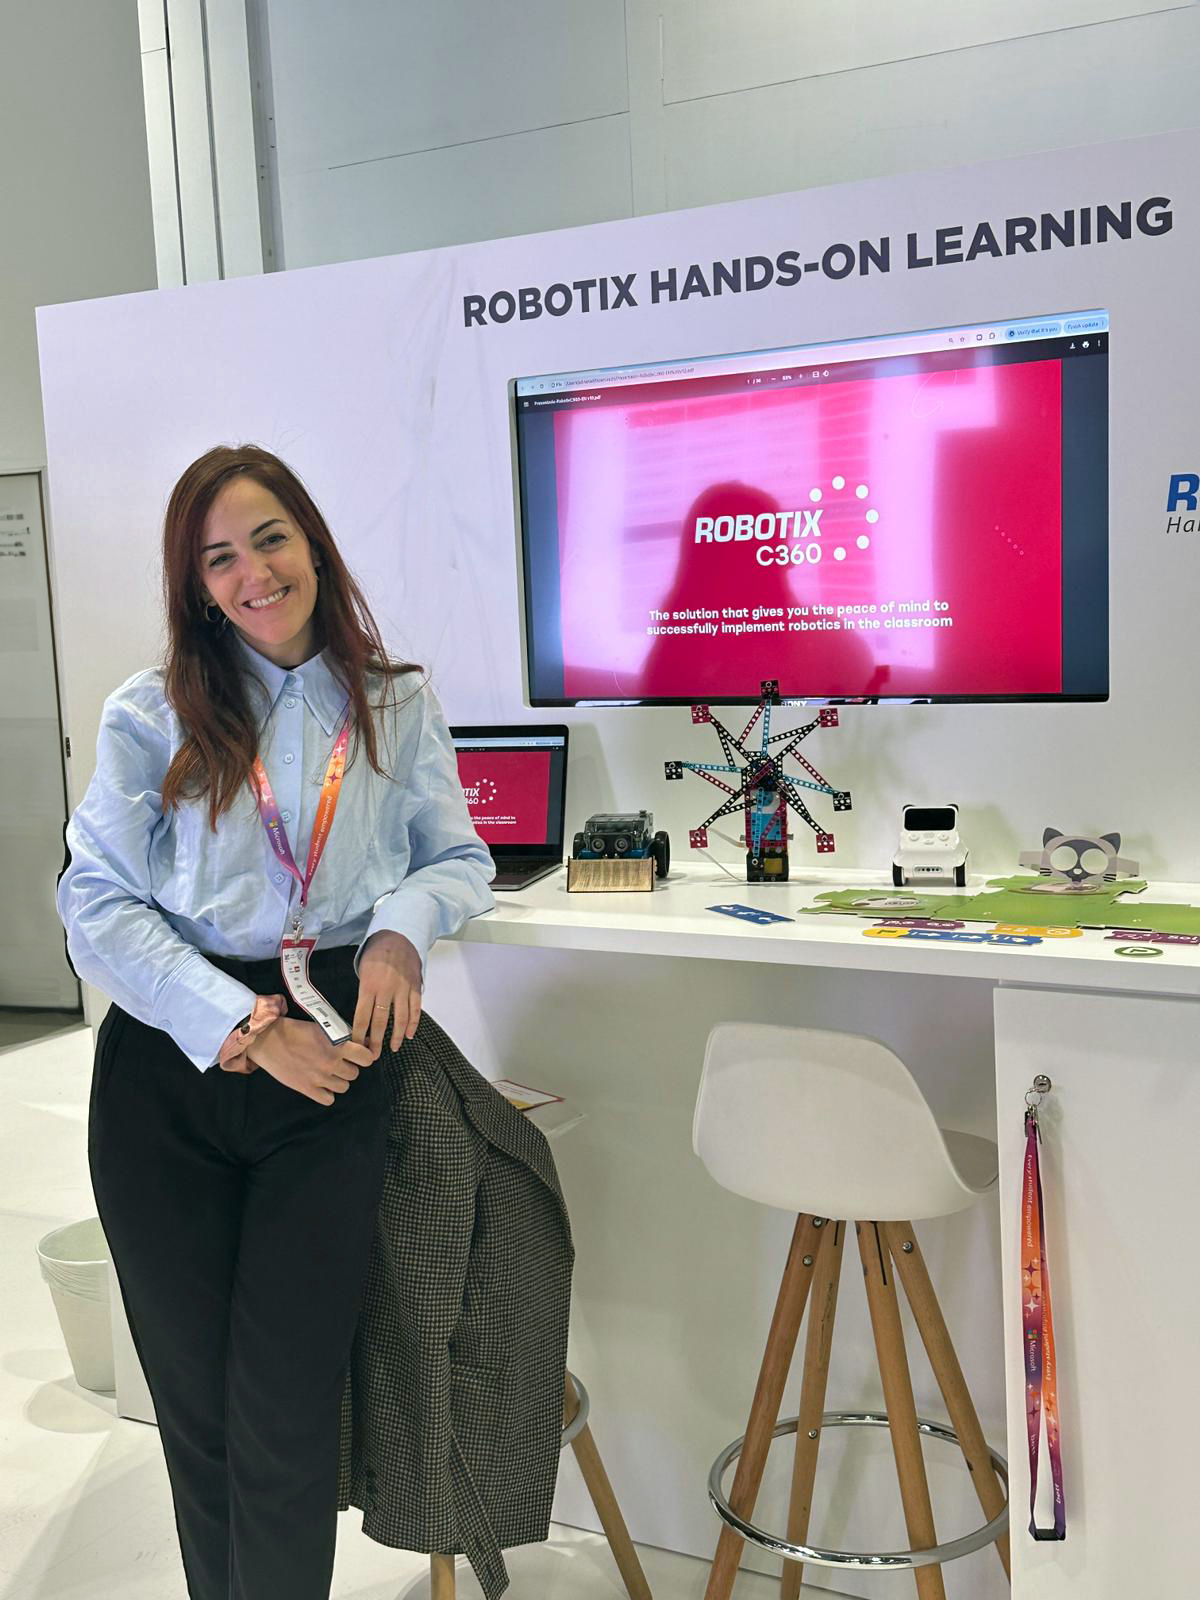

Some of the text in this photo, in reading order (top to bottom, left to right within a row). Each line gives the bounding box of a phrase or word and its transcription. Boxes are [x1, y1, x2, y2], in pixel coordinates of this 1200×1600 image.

[463, 197, 1173, 327] ROBOTIX HANDS-ON LEARNING
[695, 510, 823, 543] ROBOTIX
[1166, 516, 1200, 534] Ha
[756, 543, 822, 566] C360
[649, 600, 949, 620] The solution that gives you the peace of mind to
[646, 615, 953, 637] successfully implement robotics in the classroom
